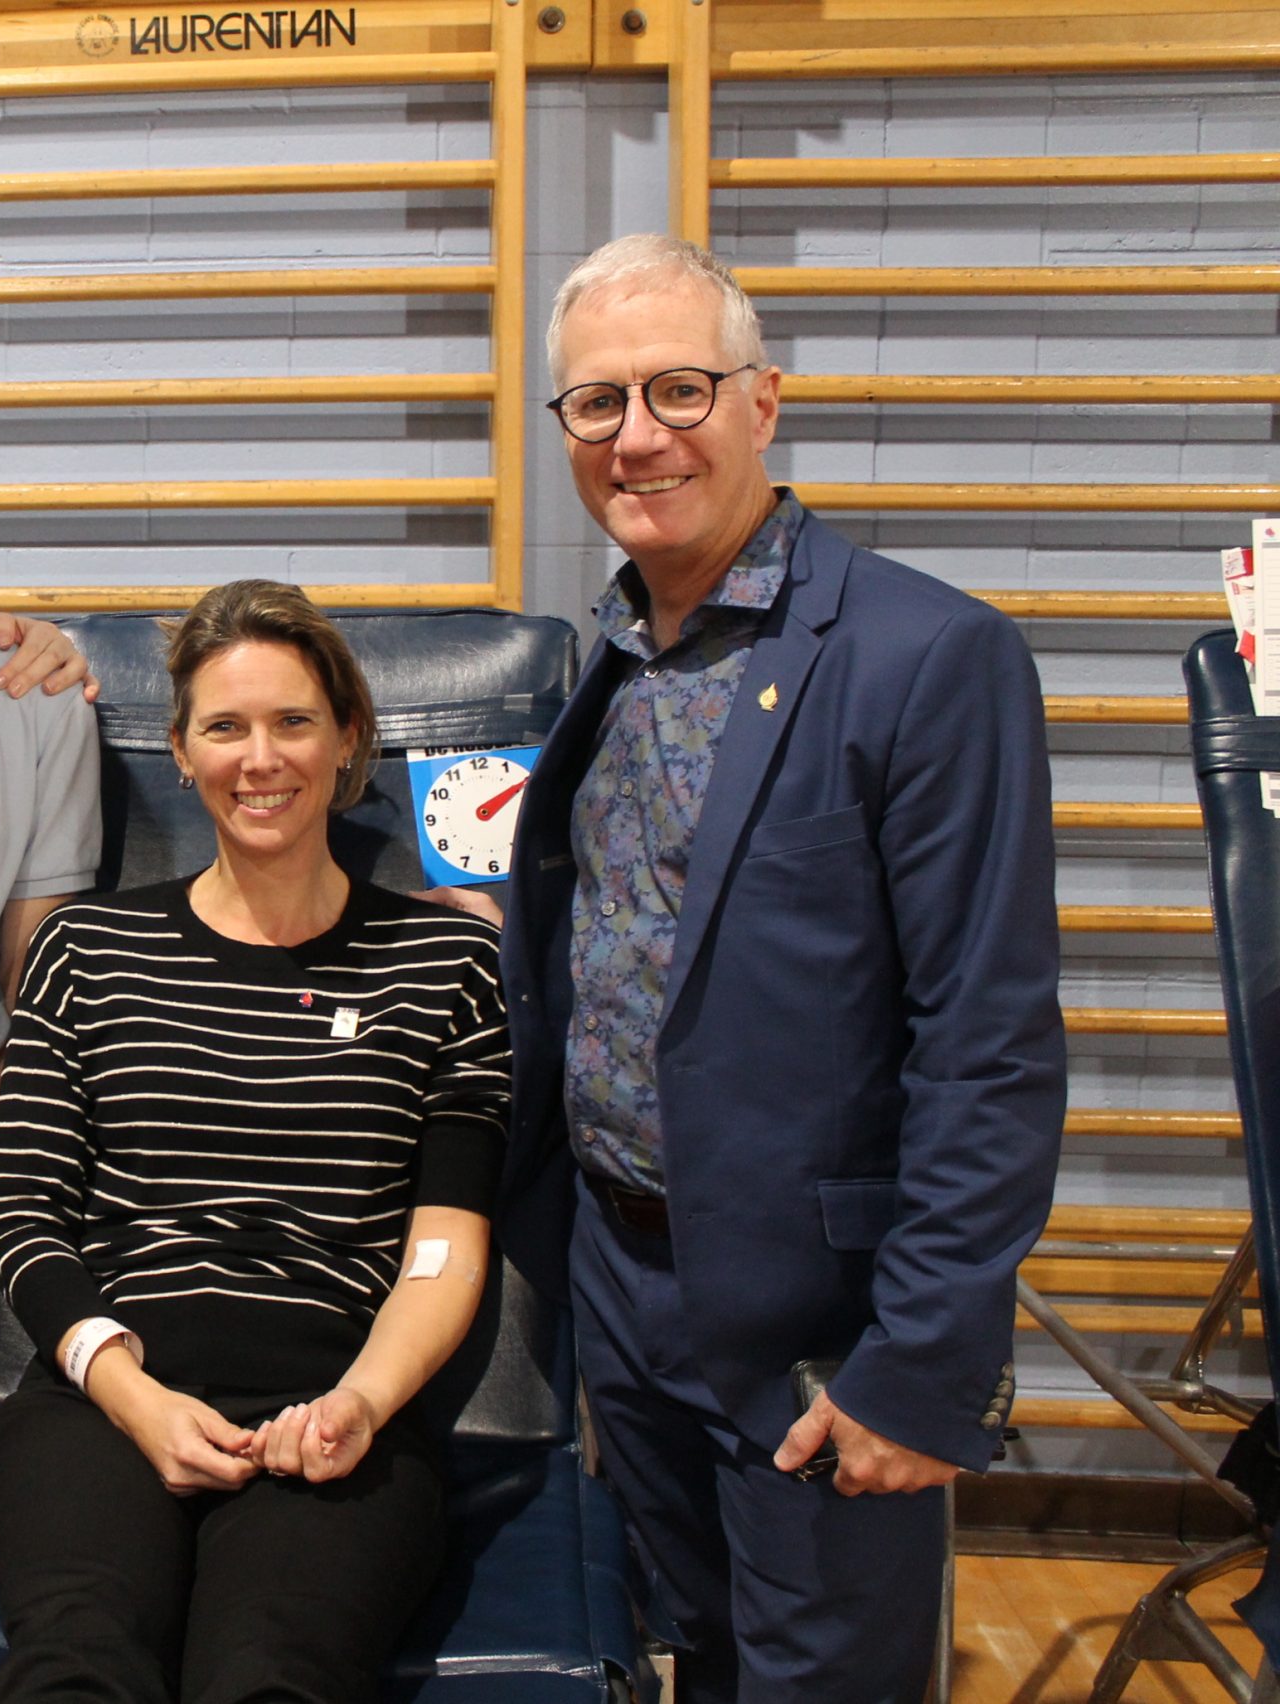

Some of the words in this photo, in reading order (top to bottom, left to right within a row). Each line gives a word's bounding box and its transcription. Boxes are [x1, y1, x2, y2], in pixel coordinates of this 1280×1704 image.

[130, 8, 356, 55] LAURENTIAN
[470, 757, 489, 770] 12
[501, 761, 510, 773] 1
[445, 768, 461, 781] 11
[430, 787, 449, 801] 10
[425, 814, 436, 827] 9
[437, 838, 449, 851] 8
[460, 856, 470, 868] 7
[488, 860, 500, 873] 6
